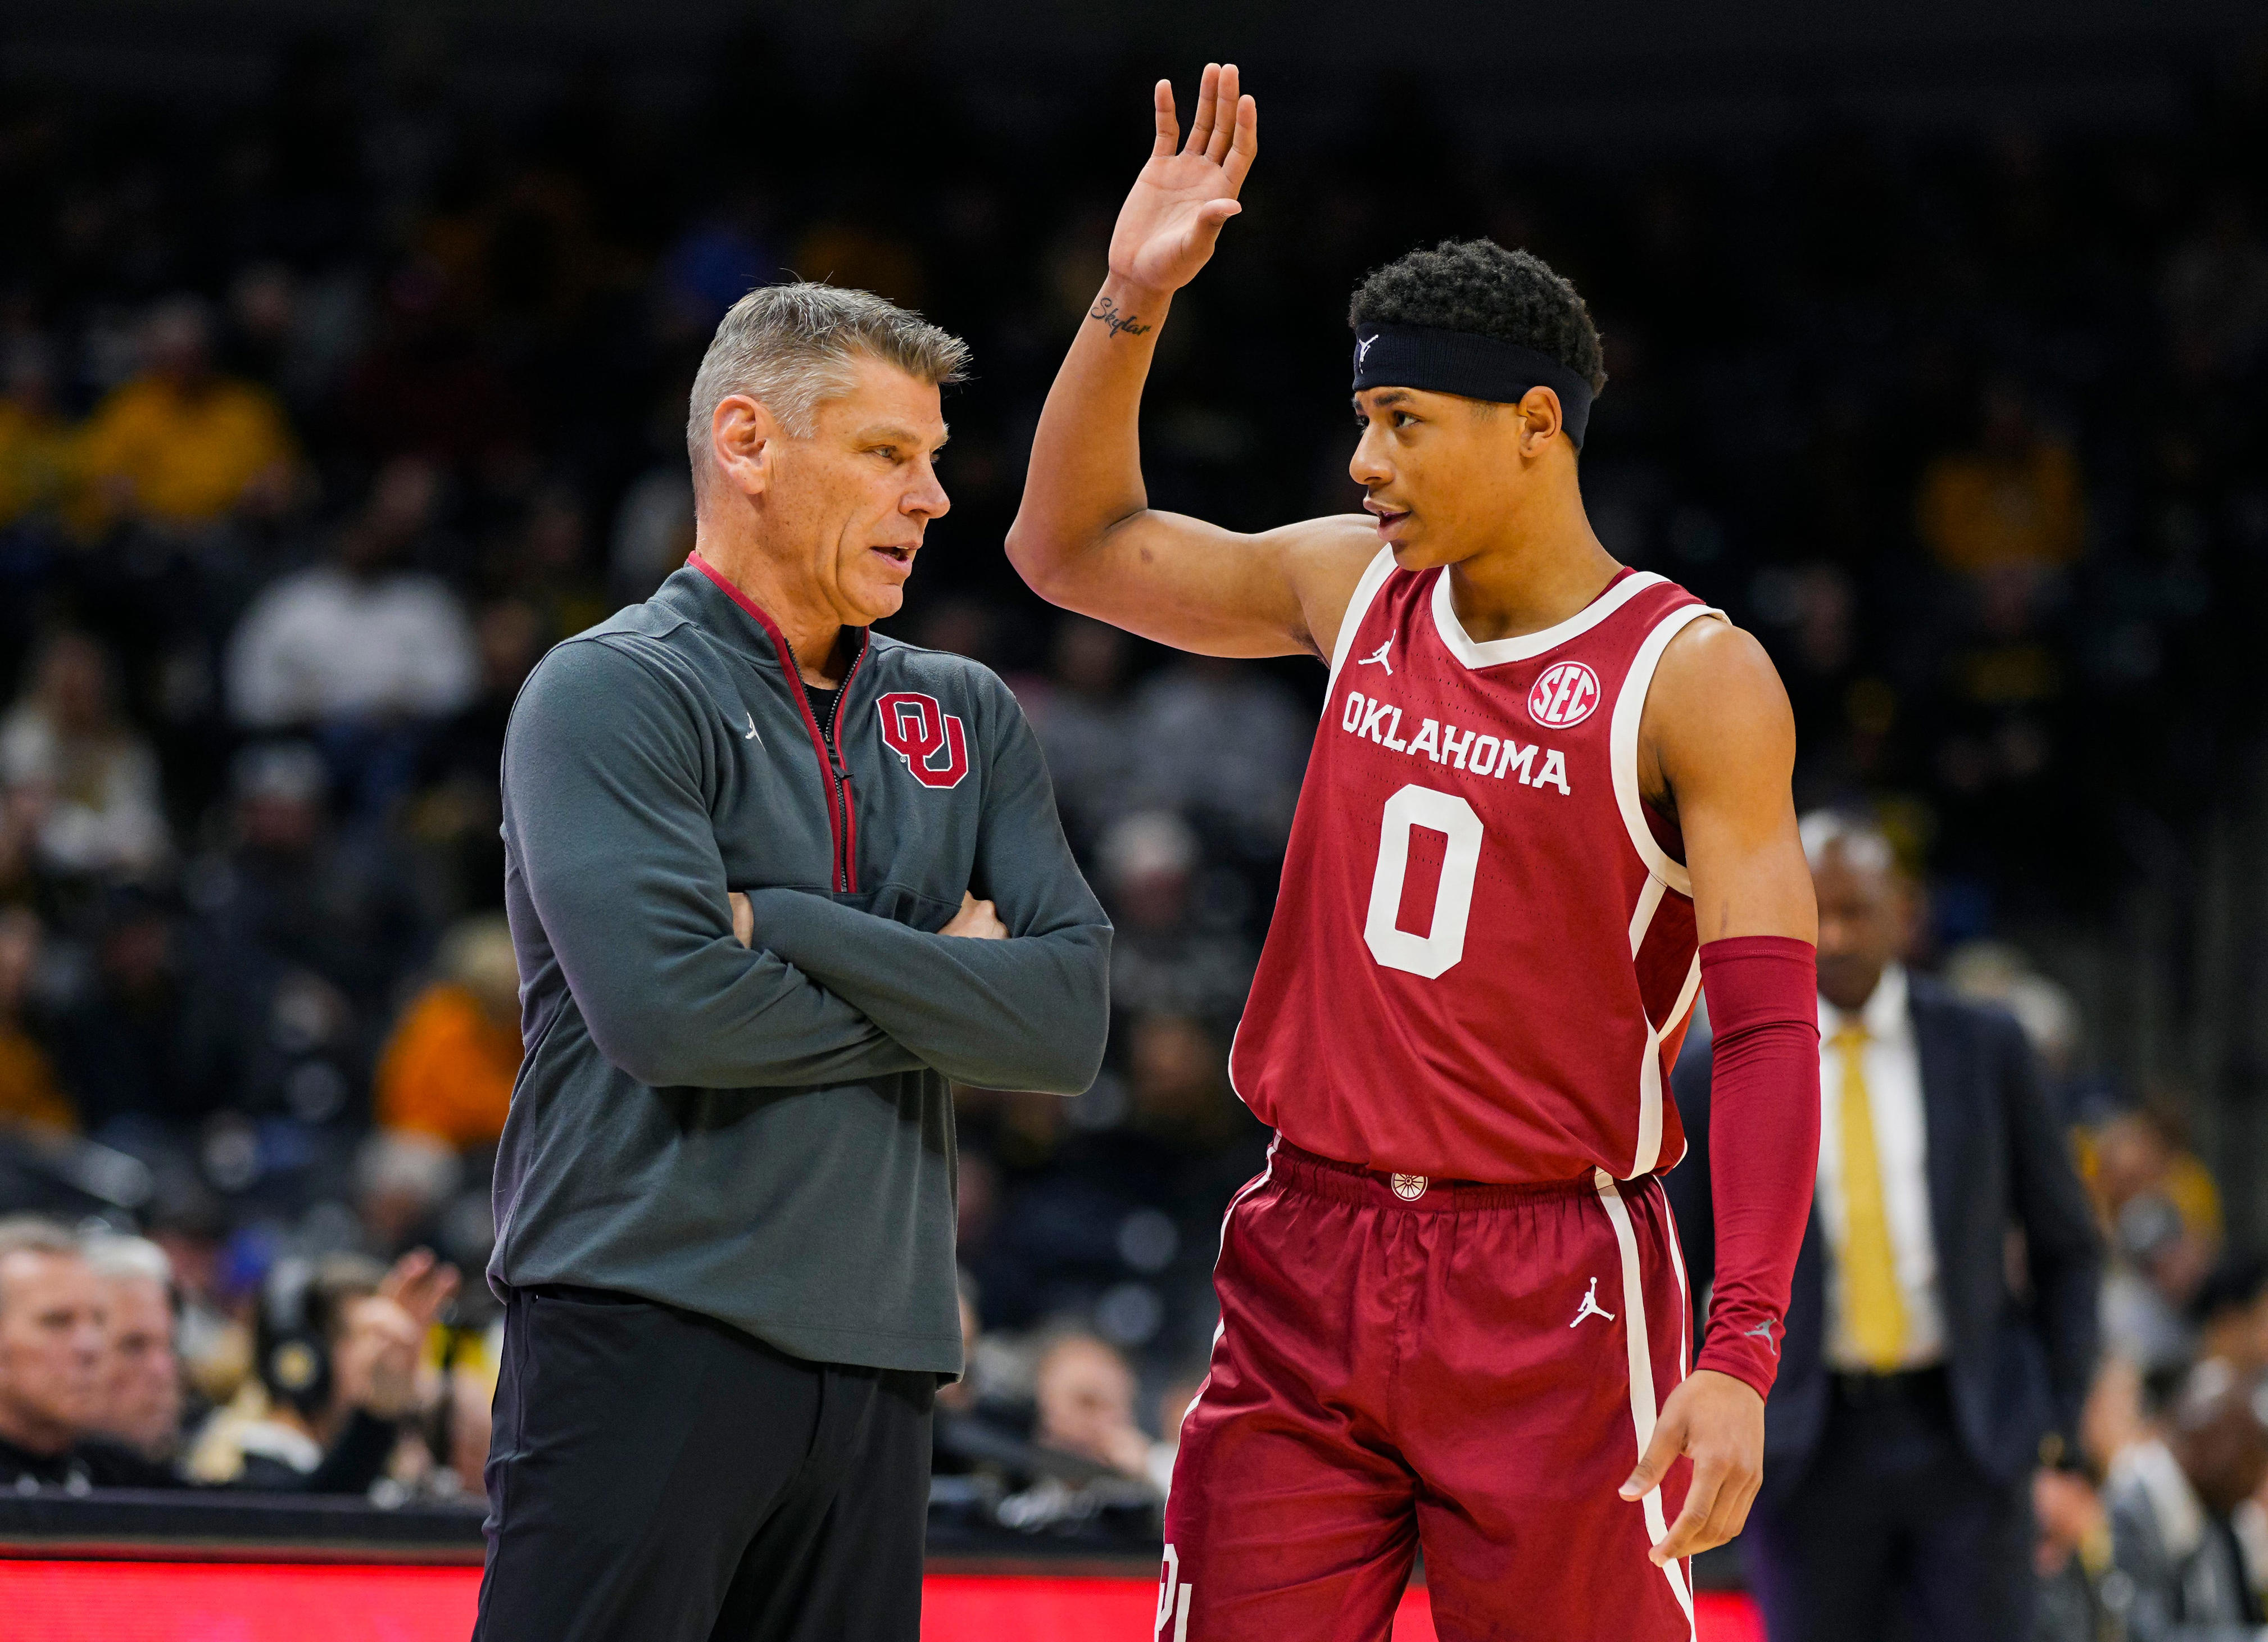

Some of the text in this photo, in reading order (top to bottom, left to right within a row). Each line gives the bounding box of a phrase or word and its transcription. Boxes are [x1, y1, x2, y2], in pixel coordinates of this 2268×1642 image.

[876, 692, 969, 789] OU
[1342, 691, 1571, 796] OKLAHOMA
[1533, 666, 1594, 722] SEC
[1363, 783, 1484, 980] 0
